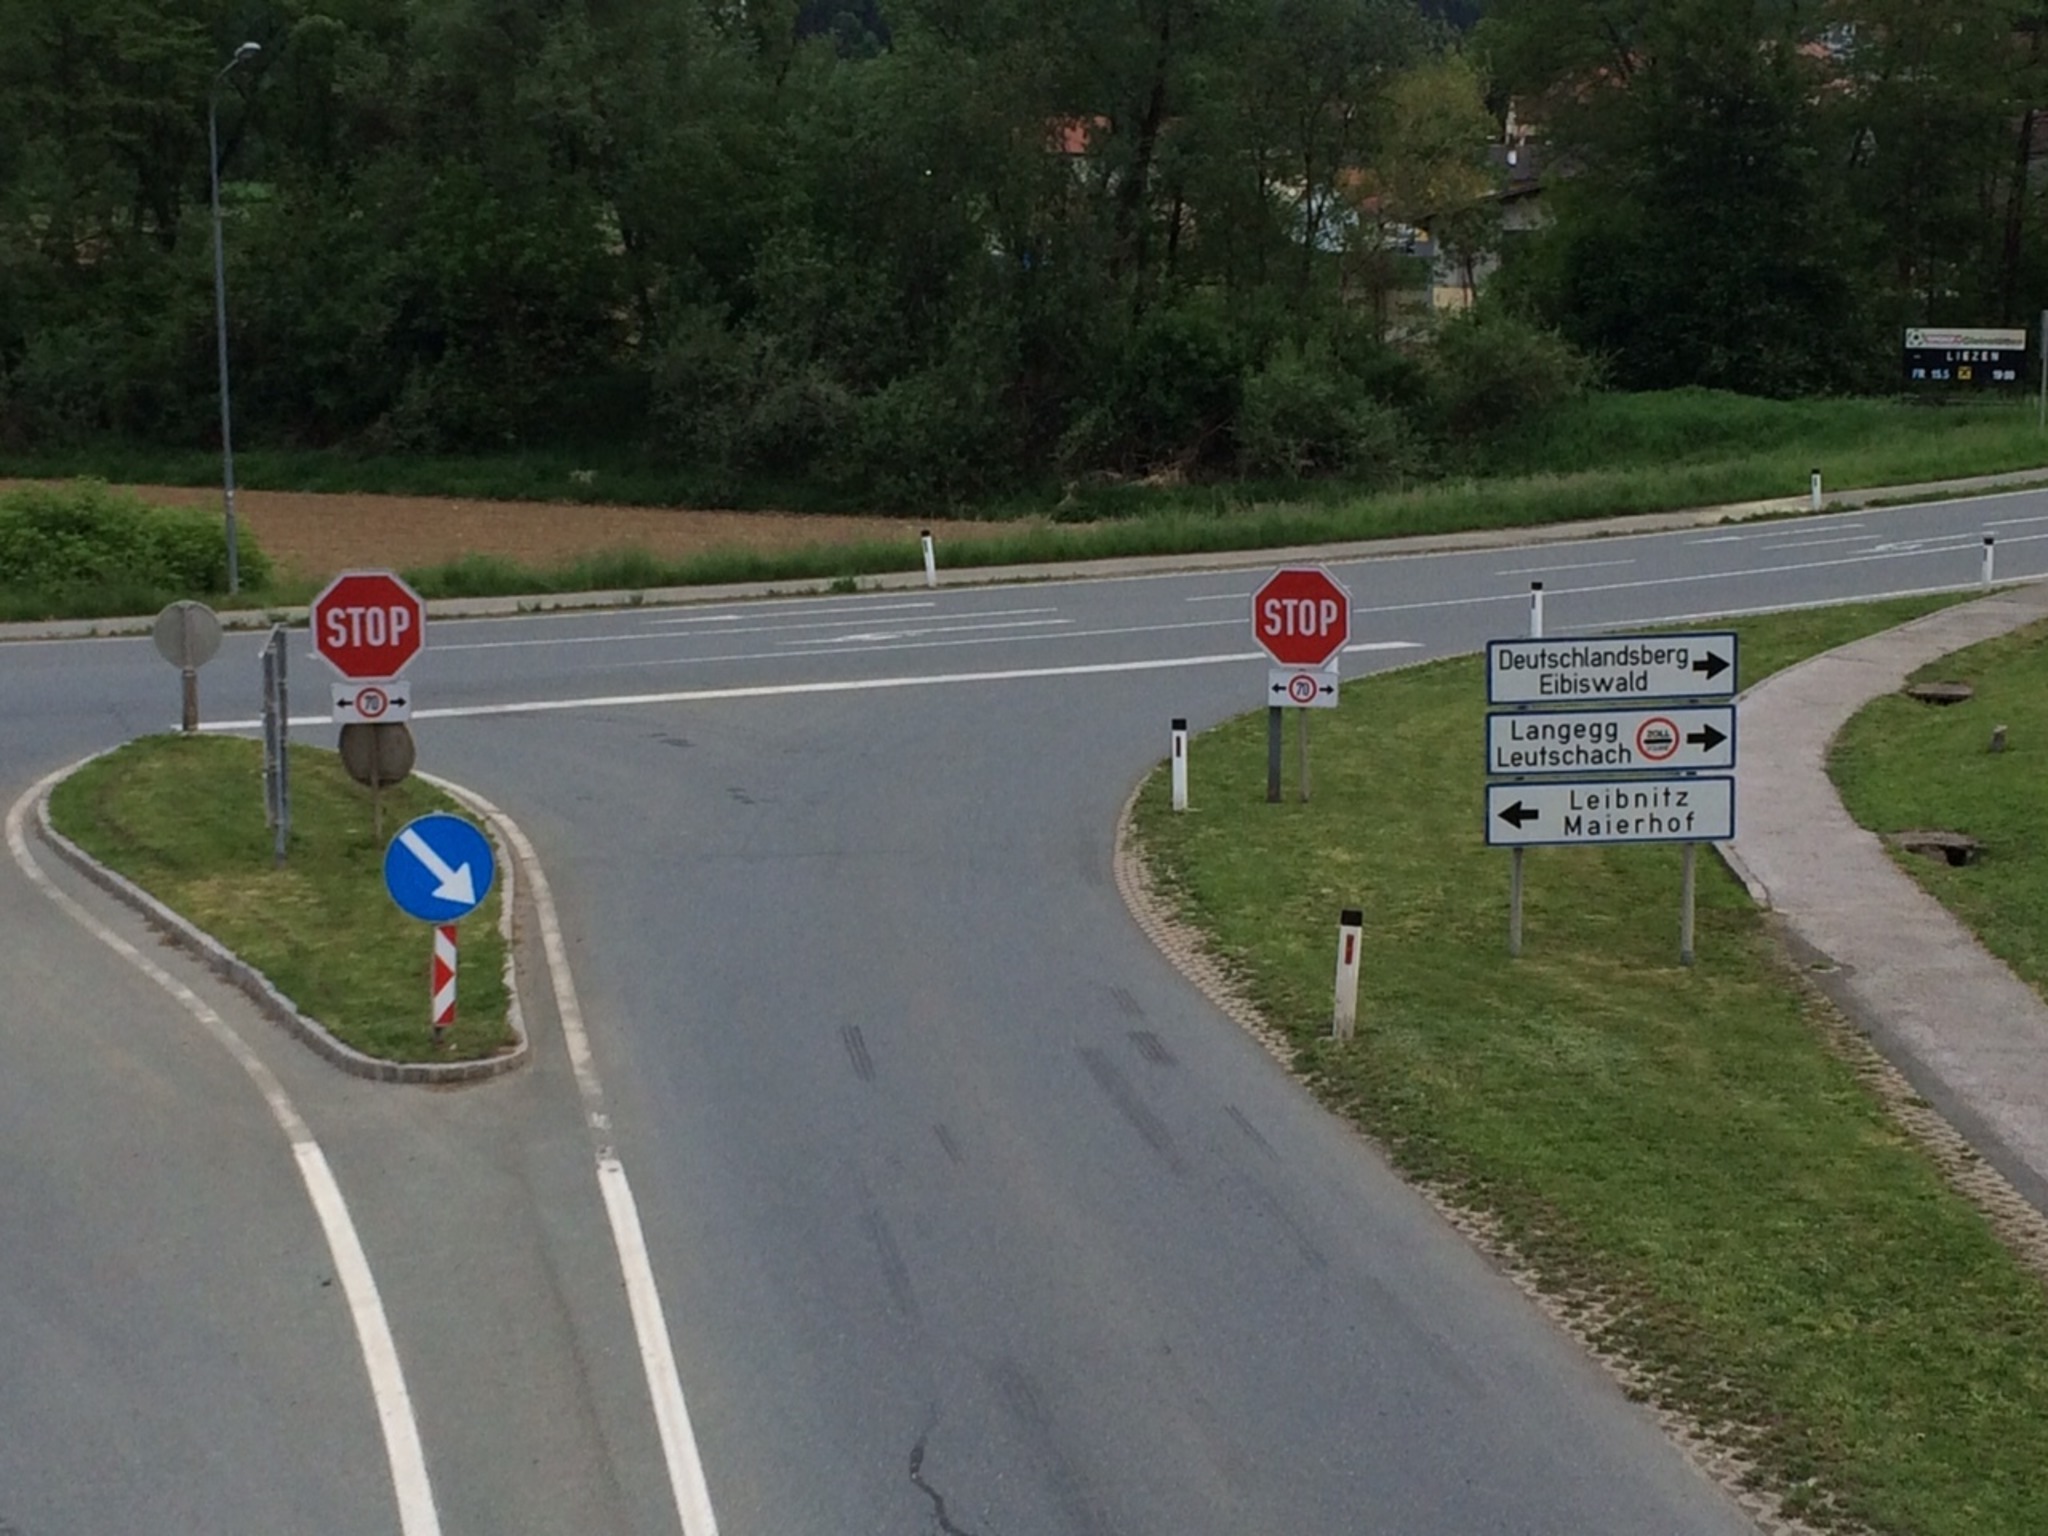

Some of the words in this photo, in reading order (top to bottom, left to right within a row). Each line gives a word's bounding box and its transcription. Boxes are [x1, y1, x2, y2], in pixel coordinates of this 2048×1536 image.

[1946, 351, 2000, 362] LIEZEN
[326, 606, 410, 647] STOP
[1264, 598, 1338, 637] STOP
[1499, 645, 1689, 670] Deutschlandsberg
[1296, 682, 1310, 697] 70
[1540, 671, 1648, 695] Eibiswald
[364, 694, 379, 711] 70
[1511, 720, 1618, 744] Langegg
[1497, 744, 1632, 768] Leutschach
[1570, 787, 1689, 811] Leibnitz
[1563, 812, 1695, 836] Maierhof
